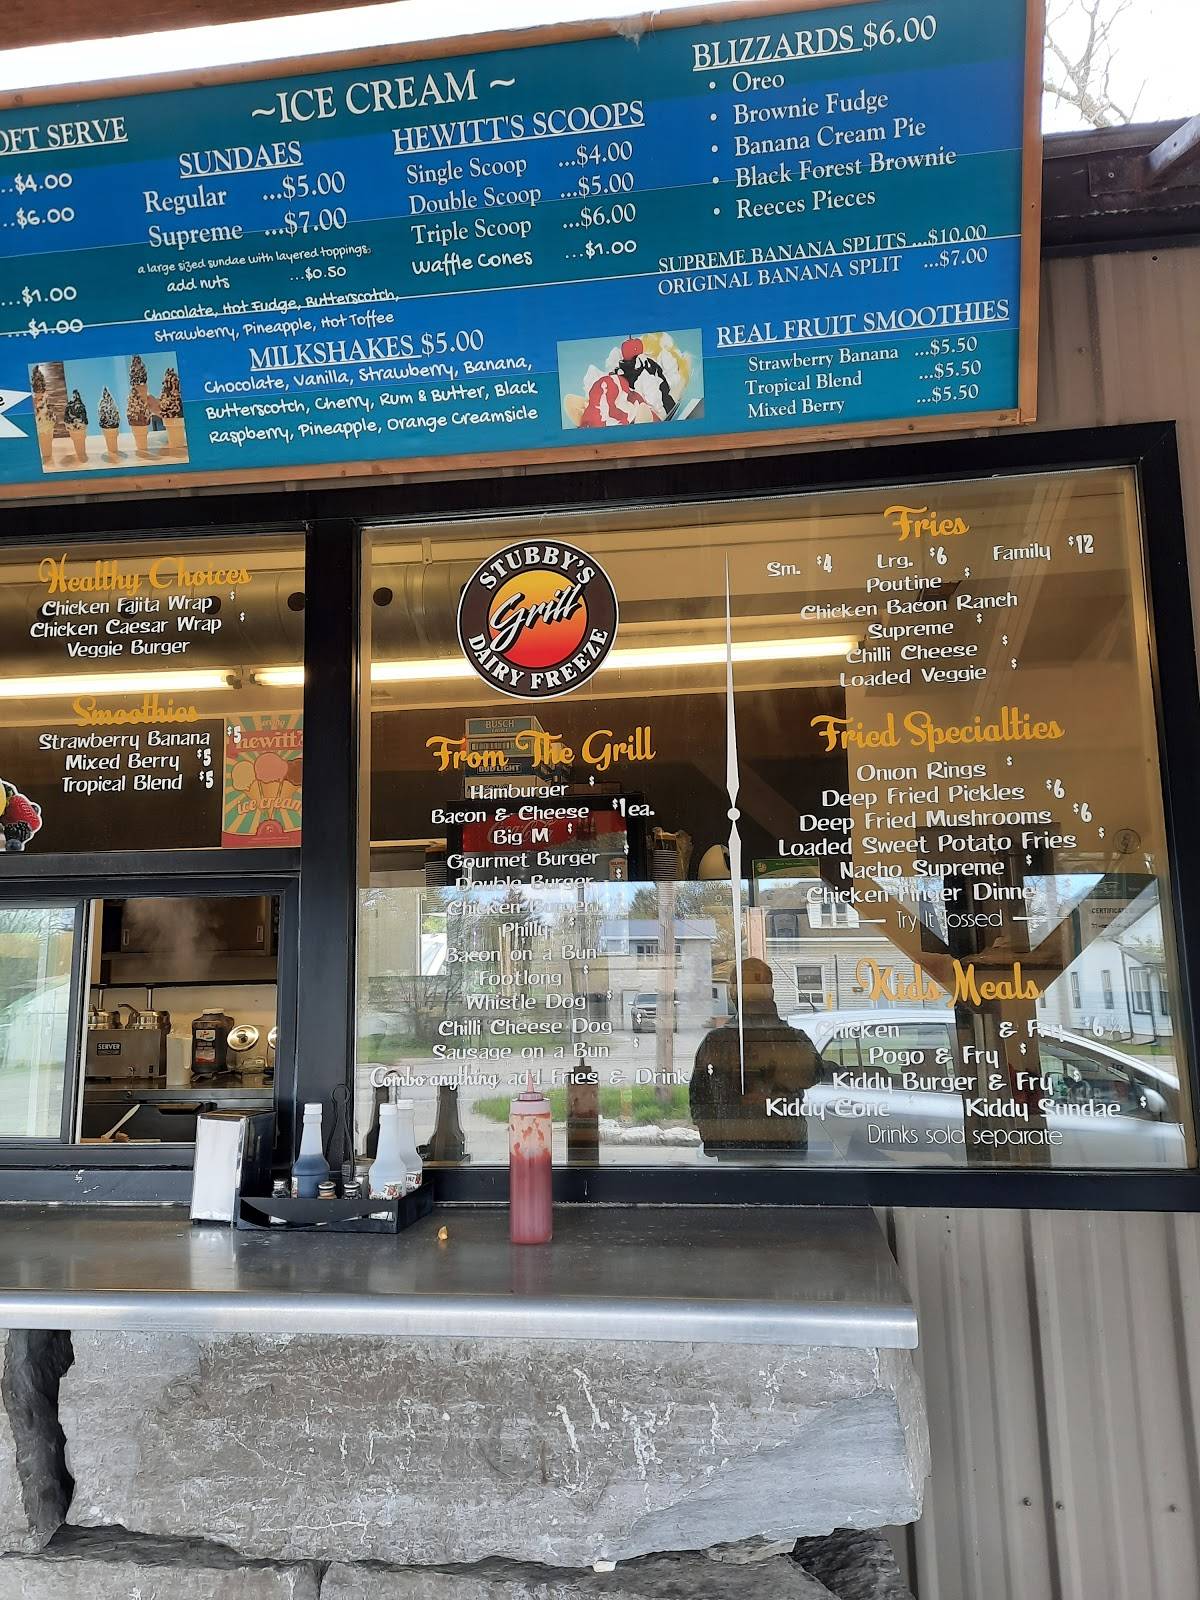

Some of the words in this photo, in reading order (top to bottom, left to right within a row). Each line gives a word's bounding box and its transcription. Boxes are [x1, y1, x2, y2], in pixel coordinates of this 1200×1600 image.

[692, 26, 854, 70] BLIZZARDS
[862, 15, 936, 50] $6.00
[345, 69, 478, 114] CREAM
[733, 72, 784, 92] Oreo
[734, 98, 819, 125] Brownie
[826, 90, 888, 114] Fudge
[48, 117, 128, 148] SERVE
[392, 114, 525, 155] HEWITT'S
[533, 100, 645, 136] SCOOPS
[734, 134, 810, 156] Banana
[817, 124, 886, 147] Cream
[893, 118, 926, 138] Pie
[179, 141, 303, 177] SUNDAES
[406, 161, 463, 184] Single
[470, 157, 527, 177] Scoop
[735, 165, 792, 188] Black
[800, 159, 861, 181] Forest
[869, 147, 957, 172] Brownie
[143, 186, 227, 216] Regular
[409, 189, 477, 215] Double
[484, 187, 541, 206] Scoop
[737, 198, 805, 219] Reeces
[812, 188, 875, 211] Pieces
[148, 225, 243, 251] Supreme
[411, 221, 468, 246] Triple
[475, 218, 532, 237] Scoop
[138, 265, 145, 274] a
[147, 261, 176, 275] large
[178, 259, 206, 272] sized
[208, 255, 246, 269] sundae
[248, 251, 273, 265] with
[276, 249, 319, 263] layered
[658, 249, 746, 272] SUPREME
[752, 240, 836, 264] BANANA
[842, 232, 906, 253] SPLITS
[167, 279, 197, 292] add
[200, 276, 230, 291] nuts
[658, 269, 752, 294] ORIGINAL
[759, 262, 843, 285] BANANA
[849, 256, 902, 277] SPLIT
[717, 323, 777, 347] REAL
[784, 315, 856, 340] FRUIT
[863, 299, 1009, 331] SMOOTHIES
[249, 336, 414, 370] MILKSHAKES
[422, 328, 484, 357] $5.00
[748, 351, 833, 373] Strawberry
[839, 347, 899, 364] Banana
[746, 377, 810, 397] Tropical
[816, 372, 862, 390] Blend
[748, 401, 796, 418] Mixed
[802, 398, 845, 414] Berry
[884, 505, 970, 541] Fries
[480, 546, 595, 590] STUBBY'S
[767, 562, 801, 577] Sm.
[816, 554, 832, 573] $4
[877, 554, 913, 569] Lrg.
[993, 543, 1051, 561] Family
[1068, 534, 1094, 554] $12
[39, 553, 141, 596] Healthy
[150, 557, 251, 590] Choices
[867, 576, 942, 593] Poutine
[41, 600, 110, 617] Chicken
[117, 598, 160, 615] Fajita
[168, 595, 212, 611] Wrap
[490, 583, 582, 651] Grill
[801, 602, 877, 620] Chicken
[887, 598, 947, 615] Bacon
[957, 593, 1017, 610] Ranch
[30, 622, 98, 638] Chicken
[105, 619, 168, 634] Caesar
[177, 616, 222, 634] Wrap
[869, 622, 954, 640] Supreme
[68, 642, 122, 658] Veggie
[131, 640, 190, 656] Burger
[469, 633, 524, 688] DAIRY
[530, 628, 608, 689] FREEZE
[847, 647, 891, 664] Chilli
[901, 643, 978, 661] Cheese
[840, 668, 910, 687] Loaded
[922, 664, 986, 681] Veggie
[72, 693, 201, 726] Smoothies
[485, 720, 514, 728] BUSCH
[810, 712, 900, 752] Fried
[904, 706, 1065, 752] Specialties
[426, 735, 509, 771] From
[516, 730, 575, 768] The
[582, 726, 655, 771] Grill
[857, 764, 916, 782] Onion
[928, 762, 986, 779] Rings
[471, 783, 569, 800] Hamburger
[822, 789, 877, 809] Deep
[888, 787, 938, 805] Fried
[949, 783, 1024, 802] Pickles
[432, 809, 486, 824] Bacon
[495, 806, 511, 821] &
[519, 805, 589, 821] Cheese
[800, 814, 854, 834] Deep
[865, 812, 916, 829] Fried
[927, 809, 1051, 828] Mushrooms
[494, 830, 522, 845] Big
[531, 828, 548, 843] M
[779, 838, 852, 857] Loaded
[863, 836, 929, 854] Sweet
[939, 834, 1012, 852] Potato
[1022, 831, 1077, 849] Fries
[447, 854, 530, 869] Gourmet
[537, 852, 600, 867] Burger
[841, 861, 902, 880] Nacho
[912, 859, 1004, 879] Supreme
[806, 886, 888, 904] Chicken
[501, 922, 548, 940] Philly
[925, 911, 942, 928] It
[946, 909, 1002, 928] Tossed
[510, 948, 532, 960] on
[543, 948, 552, 959] a
[856, 957, 942, 1002] Kids
[947, 960, 1042, 1007] Meals
[467, 994, 536, 1010] Whistle
[546, 993, 586, 1011] Dog
[438, 1019, 481, 1036] Chilli
[490, 1019, 562, 1034] Cheese
[573, 1017, 613, 1034] Dog
[999, 1021, 1016, 1038] &
[432, 1043, 511, 1061] Sausage
[522, 1045, 542, 1060] on
[554, 1046, 563, 1058] a
[574, 1042, 609, 1058] Bun
[870, 1047, 924, 1065] Pogo
[935, 1047, 953, 1064] &
[963, 1045, 998, 1067] Fry
[371, 1066, 425, 1089] Combo
[430, 1066, 499, 1090] anything
[552, 1068, 598, 1084] Fries
[610, 1070, 627, 1084] &
[833, 1072, 893, 1093] Kiddy
[902, 1073, 977, 1092] Burger
[988, 1075, 1006, 1090] &
[1017, 1072, 1054, 1095] Fry
[766, 1097, 825, 1120] Kiddy
[966, 1098, 1029, 1121] Kiddy
[1039, 1099, 1121, 1118] Sundae
[868, 1125, 918, 1144] Drinks
[926, 1126, 965, 1144] sold
[973, 1128, 1063, 1147] separate
